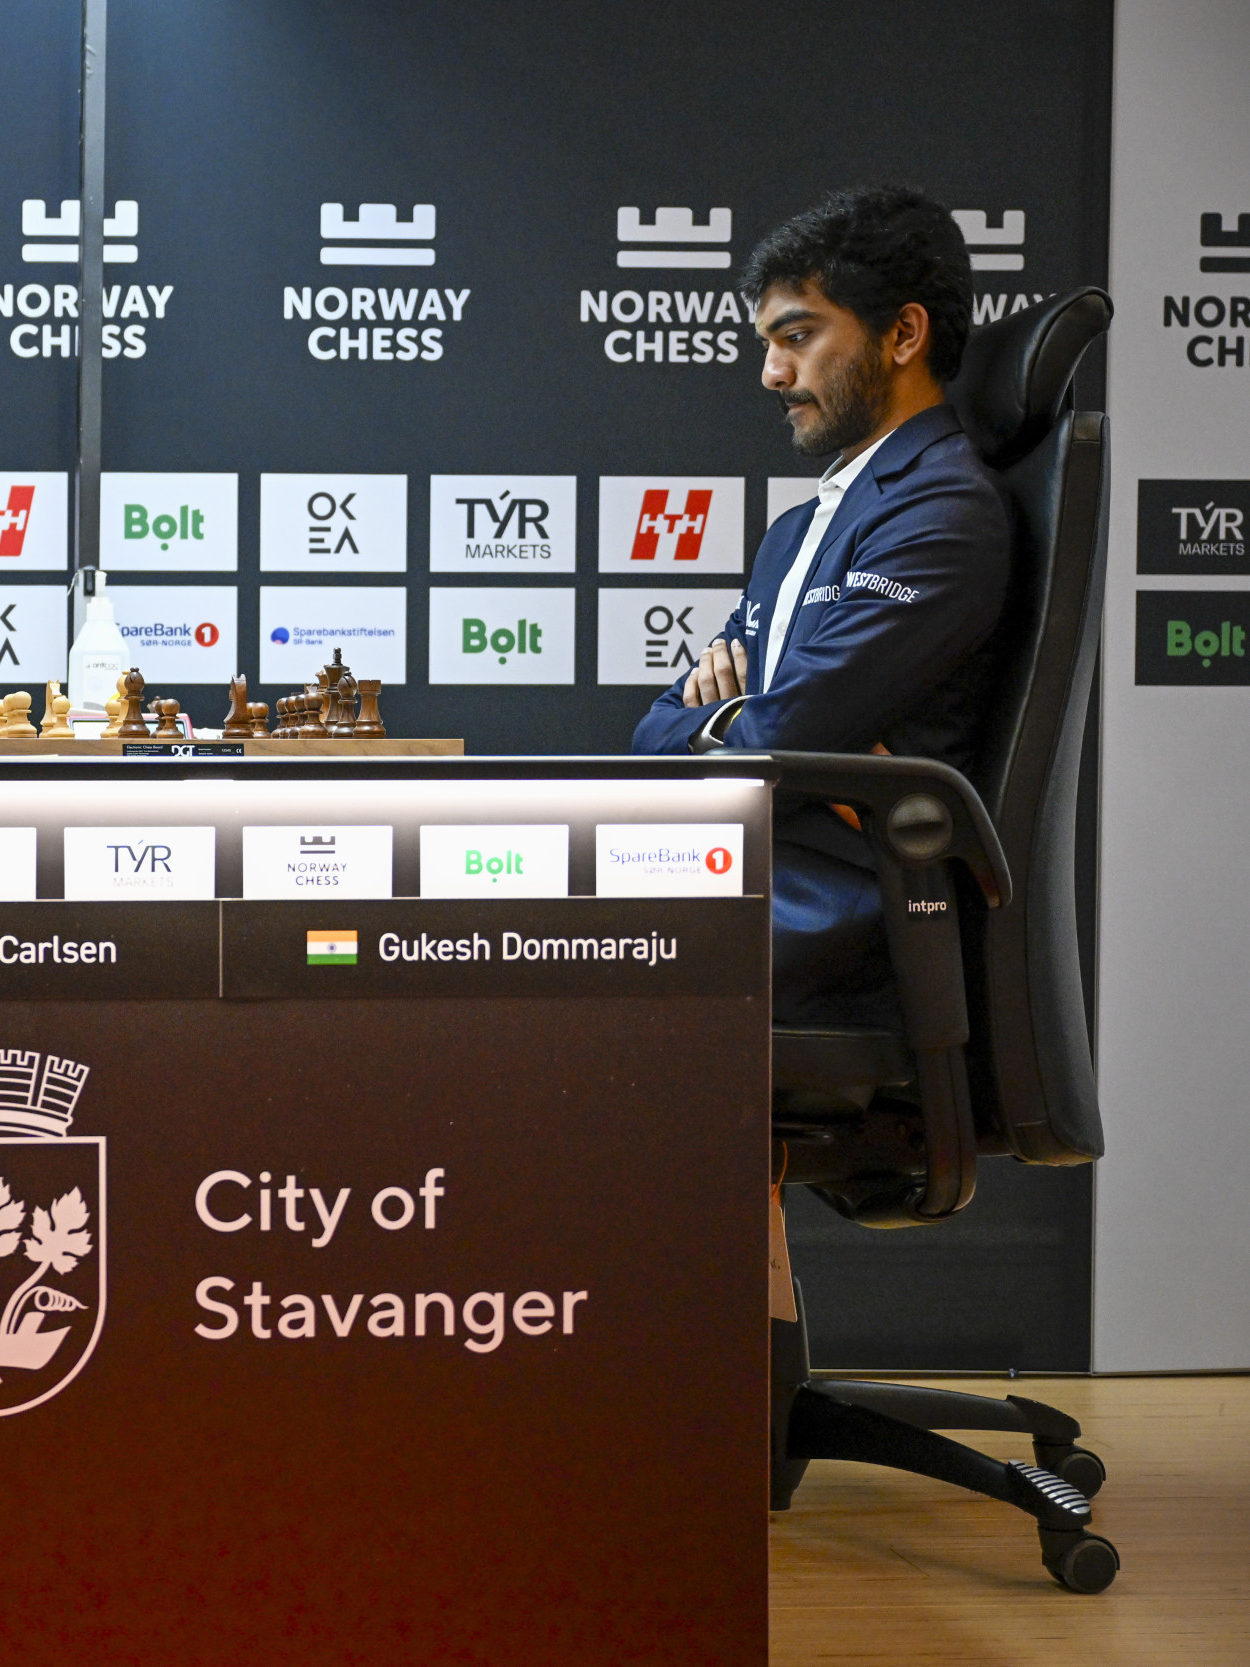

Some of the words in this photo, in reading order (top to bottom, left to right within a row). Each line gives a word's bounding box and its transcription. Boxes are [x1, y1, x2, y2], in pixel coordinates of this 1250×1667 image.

[284, 287, 470, 321] NORWAY
[1163, 295, 1250, 328] NOR
[9, 323, 146, 359] CHSS
[308, 327, 443, 361] CHESS
[604, 330, 738, 363] CHESS
[308, 492, 356, 521] OK
[456, 490, 549, 539] TÝR
[1172, 502, 1243, 540] TÝR
[124, 504, 204, 551] Bolt
[466, 544, 551, 559] MARKETS
[1179, 543, 1244, 555] MARKETS
[802, 585, 841, 607] WESTBRIDG
[846, 571, 919, 603] WESTBRIDGE
[116, 622, 191, 638] pareBank
[293, 628, 394, 639] Sparebankstiftelsen
[644, 606, 693, 635] OK
[462, 619, 542, 665] Bolt
[1167, 620, 1245, 668] Bolt
[171, 745, 195, 756] DGT
[107, 841, 171, 872] TÝR
[288, 863, 346, 872] NORWAY
[466, 850, 523, 883] Bolt
[609, 848, 701, 865] SpareBank
[113, 878, 173, 887] MARKETS
[296, 876, 338, 885] CHESS
[909, 900, 946, 914] intpro
[379, 933, 490, 961] Gukesh
[503, 931, 676, 966] Dommaraju
[195, 1169, 351, 1248] City
[371, 1168, 444, 1230] of
[195, 1276, 587, 1353] Stavanger
